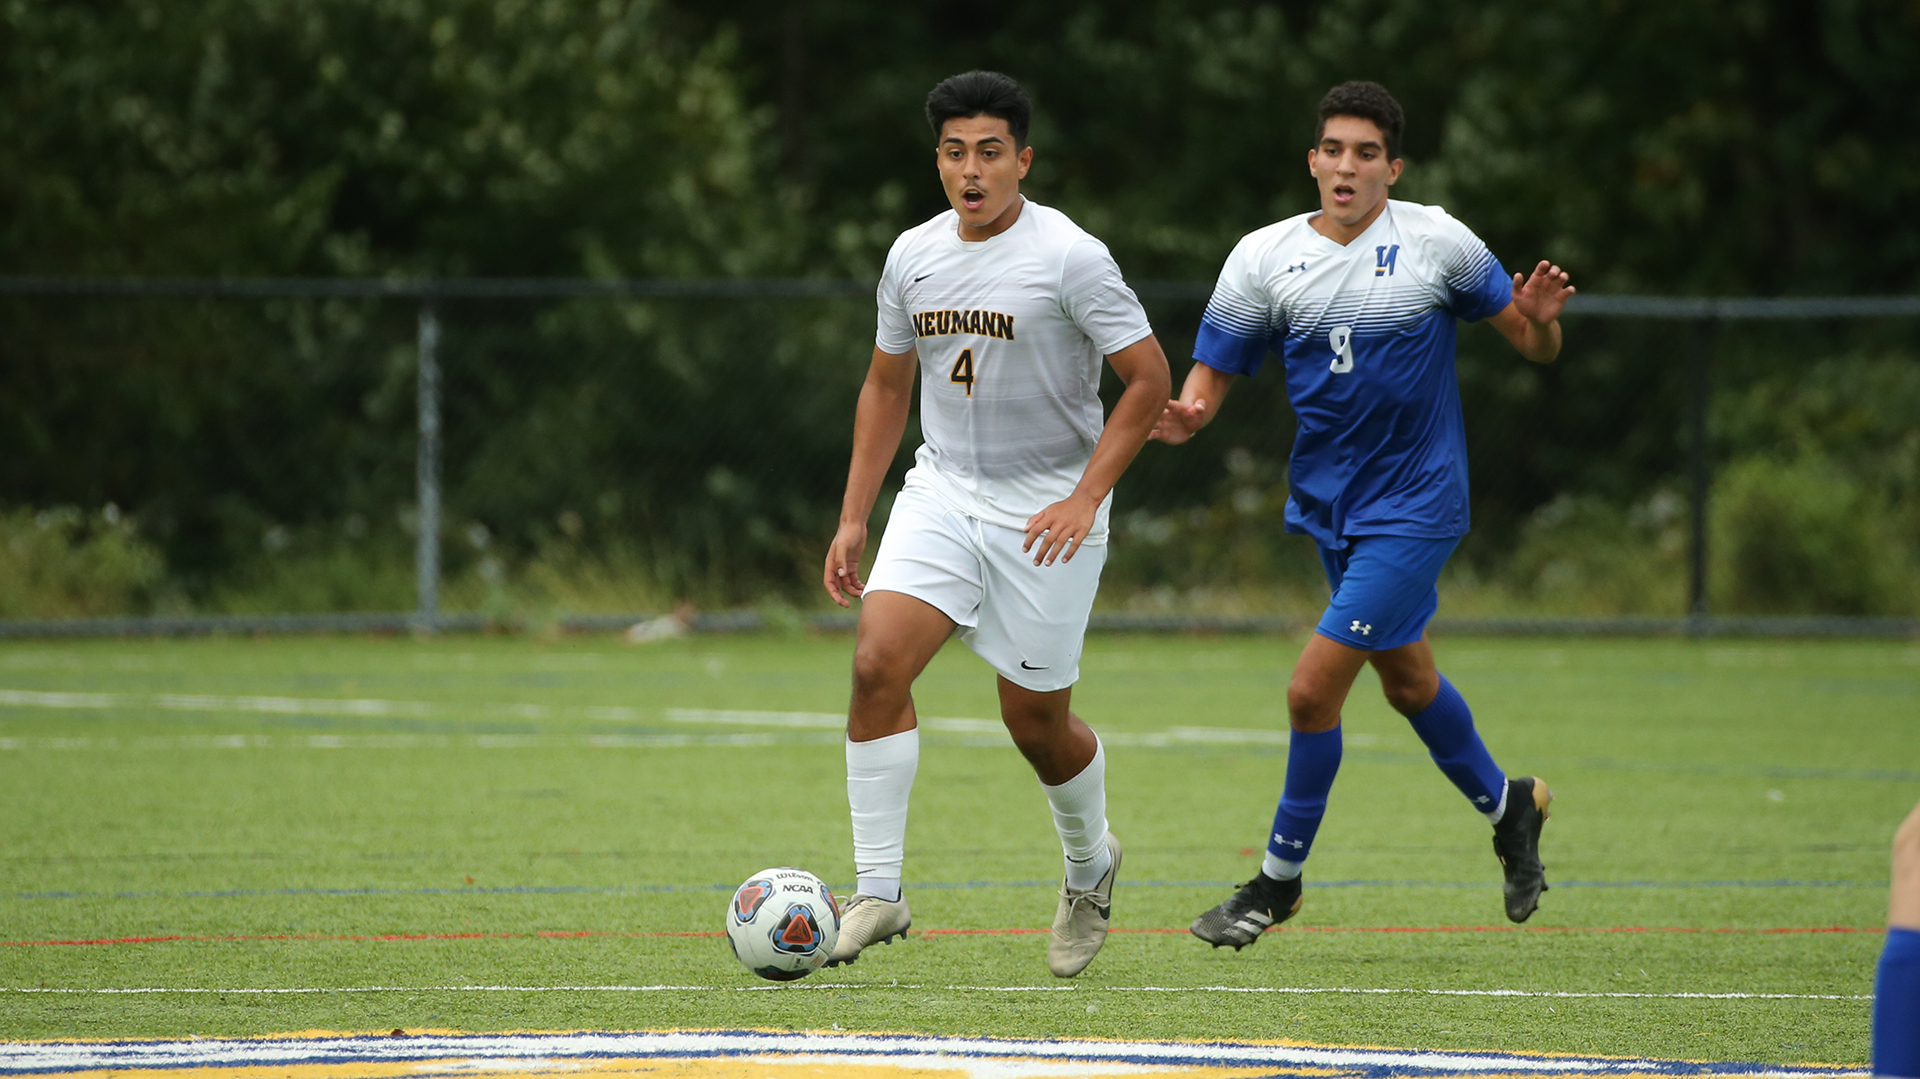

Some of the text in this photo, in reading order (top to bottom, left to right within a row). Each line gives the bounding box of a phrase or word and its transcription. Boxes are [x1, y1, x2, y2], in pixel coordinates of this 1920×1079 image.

[912, 309, 1015, 341] NEUMANN
[1328, 325, 1354, 374] 9
[950, 348, 975, 398] 4
[782, 884, 814, 894] NCAA
